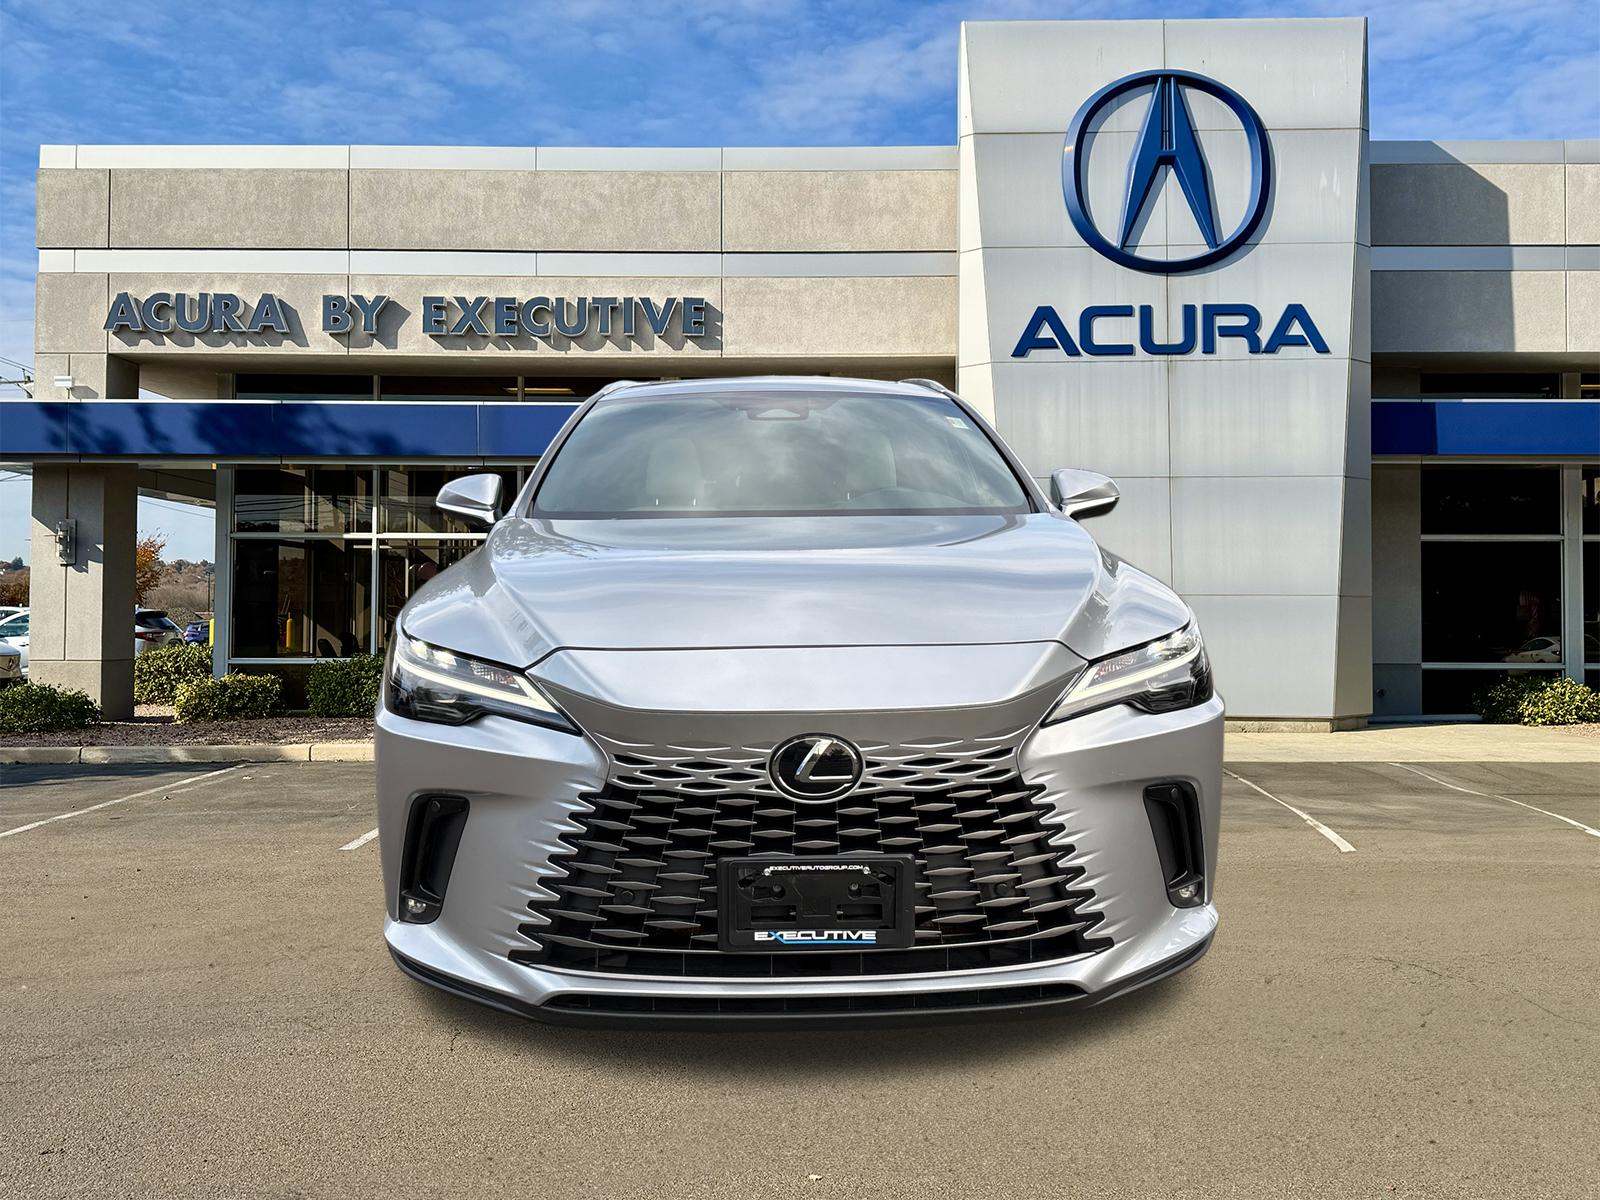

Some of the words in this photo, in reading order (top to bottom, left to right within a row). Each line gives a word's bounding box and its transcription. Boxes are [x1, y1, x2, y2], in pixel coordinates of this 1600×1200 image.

[104, 292, 289, 333] ACURA
[322, 294, 391, 334] BY
[421, 295, 706, 336] EXECUTIVE
[1011, 304, 1331, 357] ACURA
[754, 930, 876, 942] EXECUTIVE
